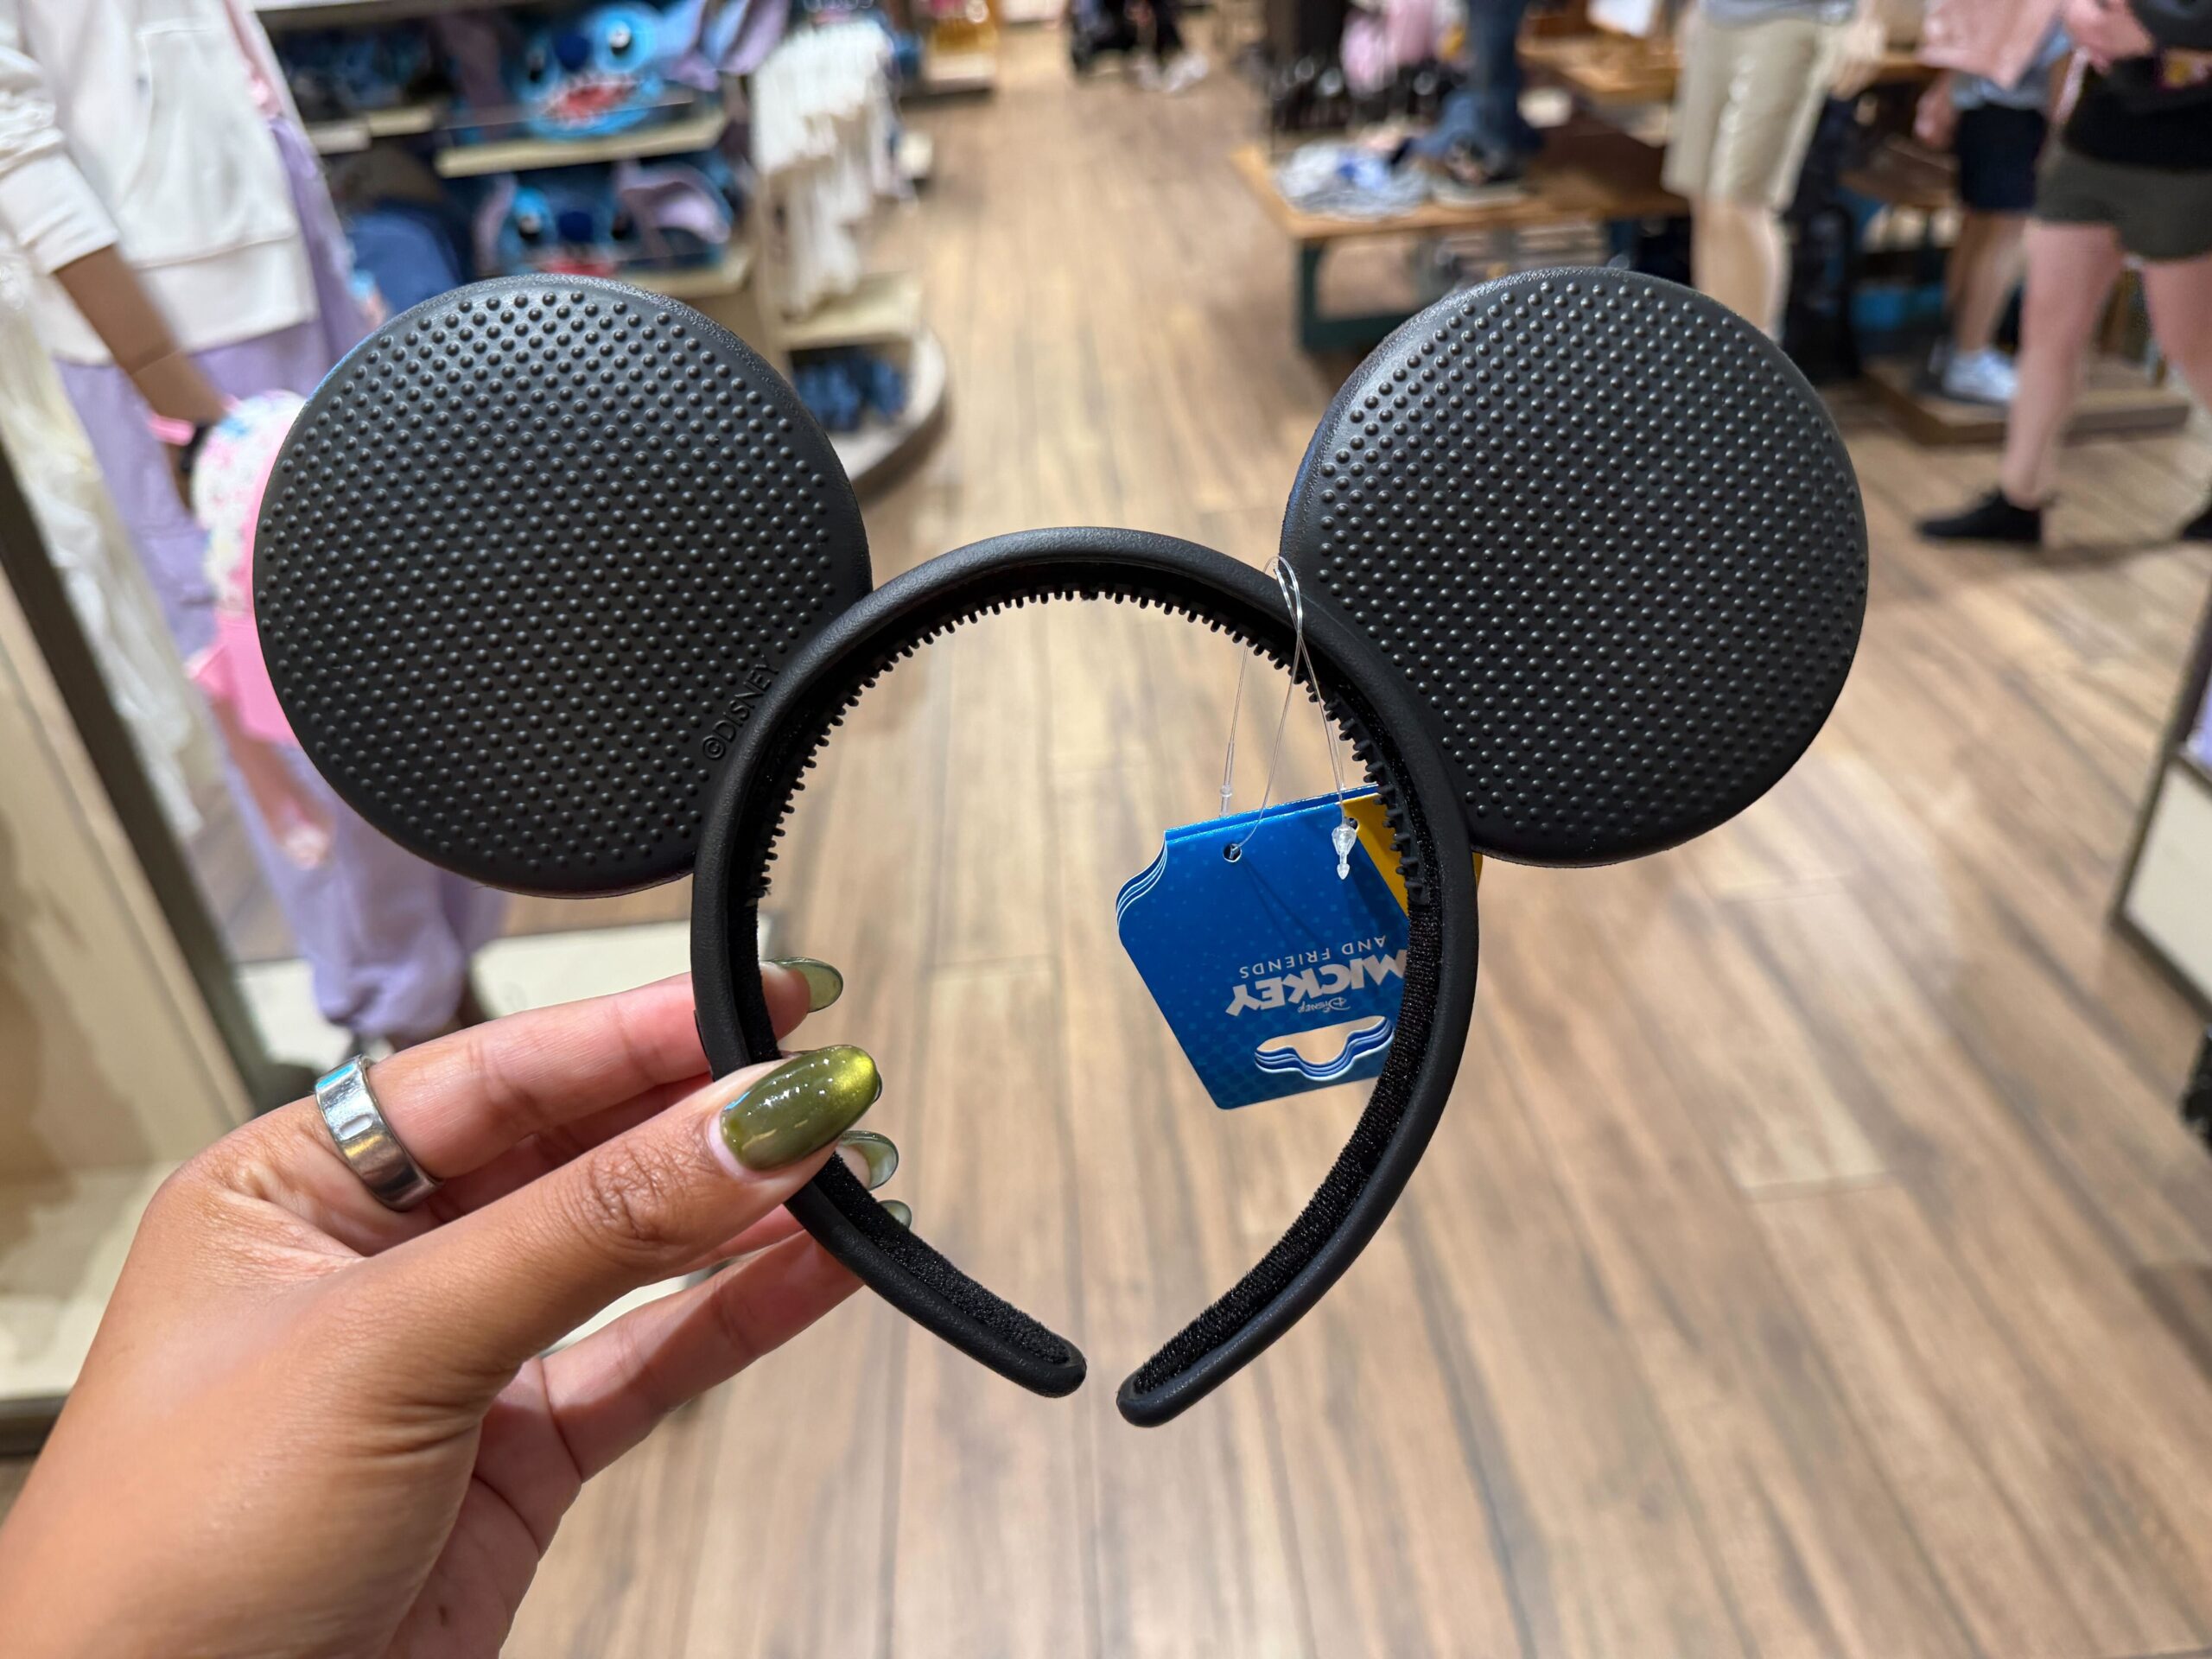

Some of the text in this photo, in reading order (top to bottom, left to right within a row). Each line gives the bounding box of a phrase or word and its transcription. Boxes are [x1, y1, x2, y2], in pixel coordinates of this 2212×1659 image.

[702, 654, 779, 760] ©DISNEY
[1225, 949, 1408, 1017] MICKEY
[1239, 935, 1387, 979] AND FRIENDS
